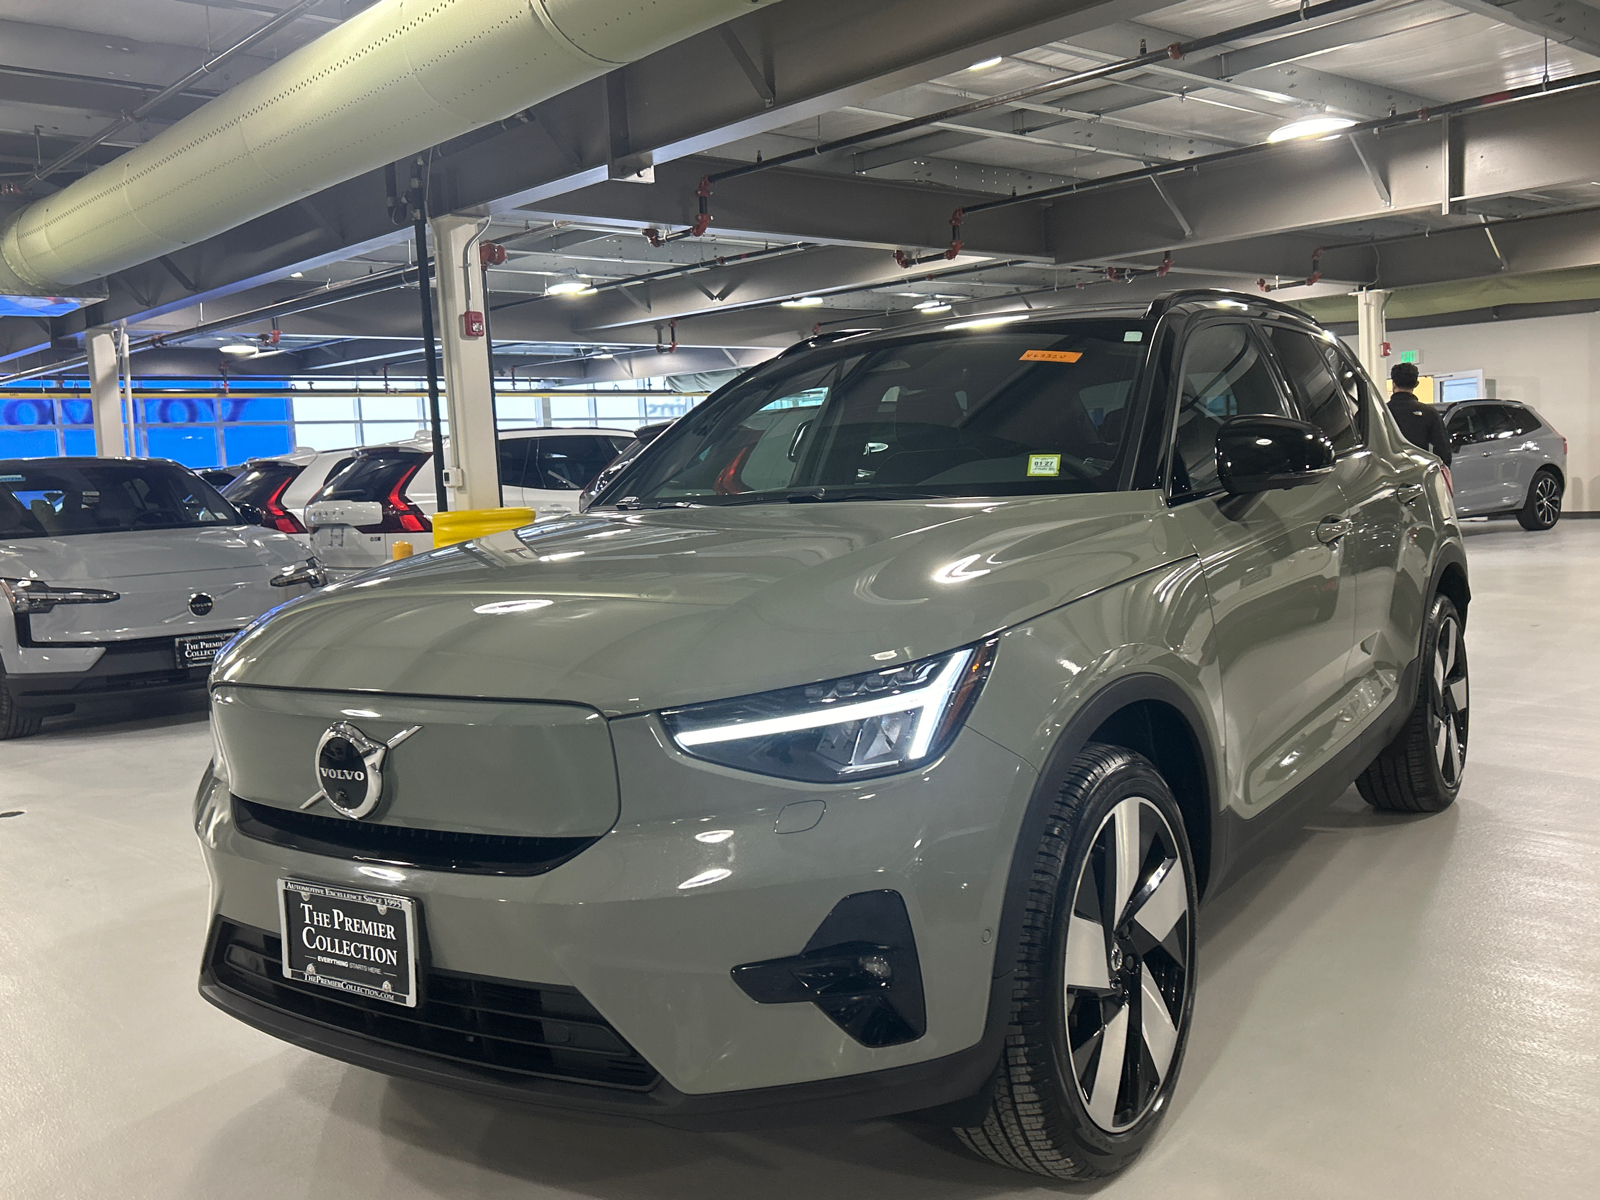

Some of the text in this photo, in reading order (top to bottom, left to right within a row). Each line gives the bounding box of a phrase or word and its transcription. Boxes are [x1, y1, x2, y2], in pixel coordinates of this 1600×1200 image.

[320, 767, 365, 781] VOLVO
[384, 898, 402, 908] 1995
[332, 908, 397, 941] PREMIER
[302, 926, 398, 966] COLLECTION
[317, 955, 349, 968] EVERYTHING
[349, 962, 368, 972] STARTS
